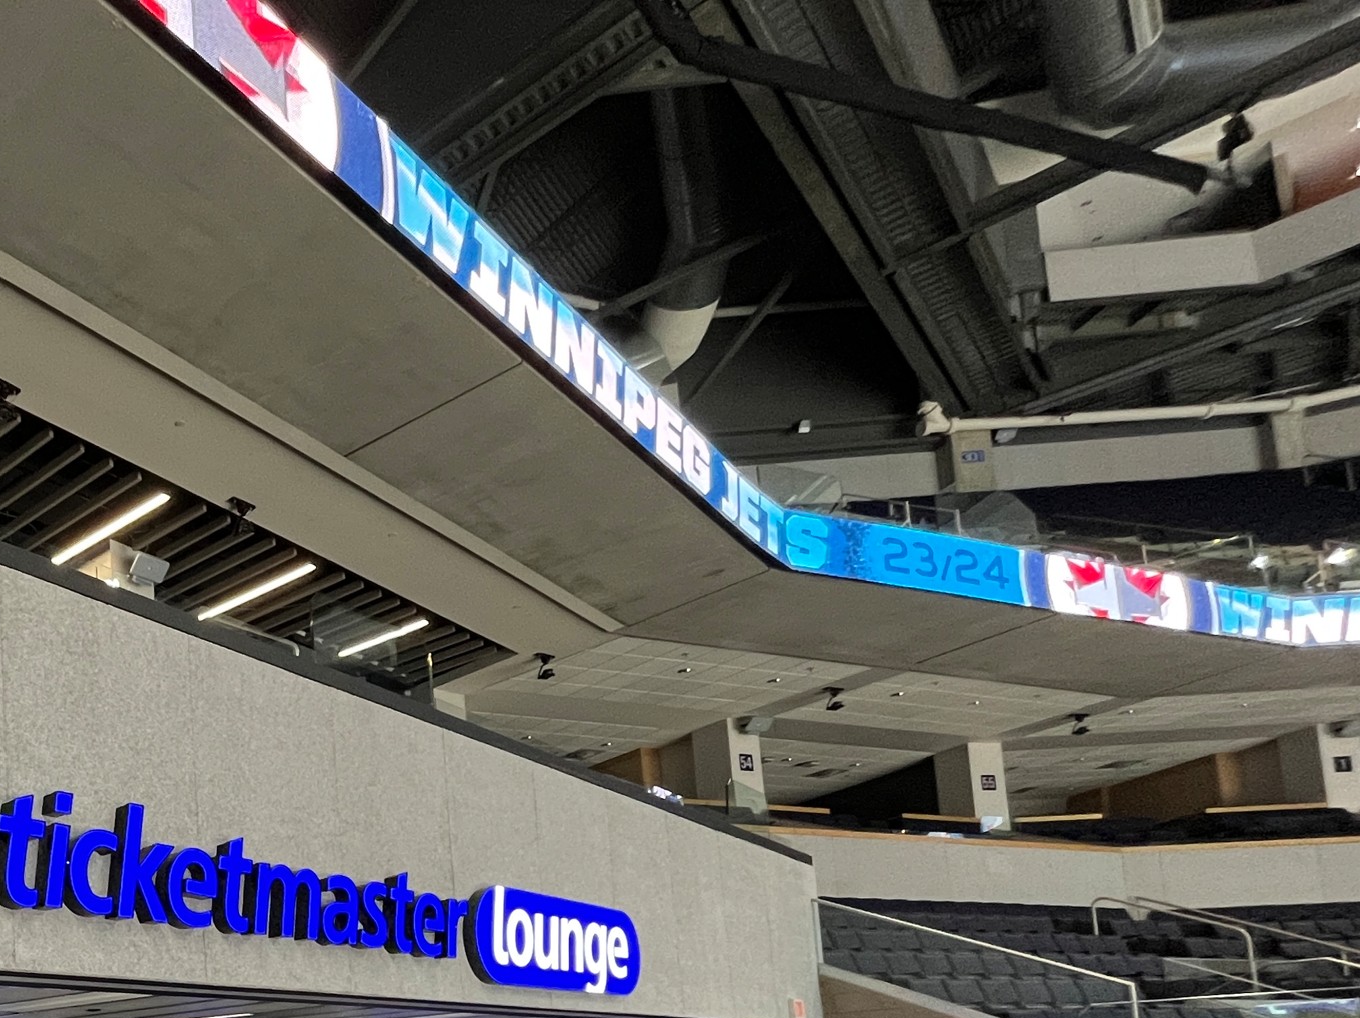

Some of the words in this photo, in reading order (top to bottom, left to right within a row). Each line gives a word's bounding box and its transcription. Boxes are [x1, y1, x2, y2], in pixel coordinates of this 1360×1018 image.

[395, 143, 711, 496] WINNIPEG
[722, 461, 829, 569] JETS
[882, 537, 1009, 589] 23/24
[1216, 587, 1360, 643] WIN
[740, 755, 753, 770] 54
[492, 884, 629, 994] lounge
